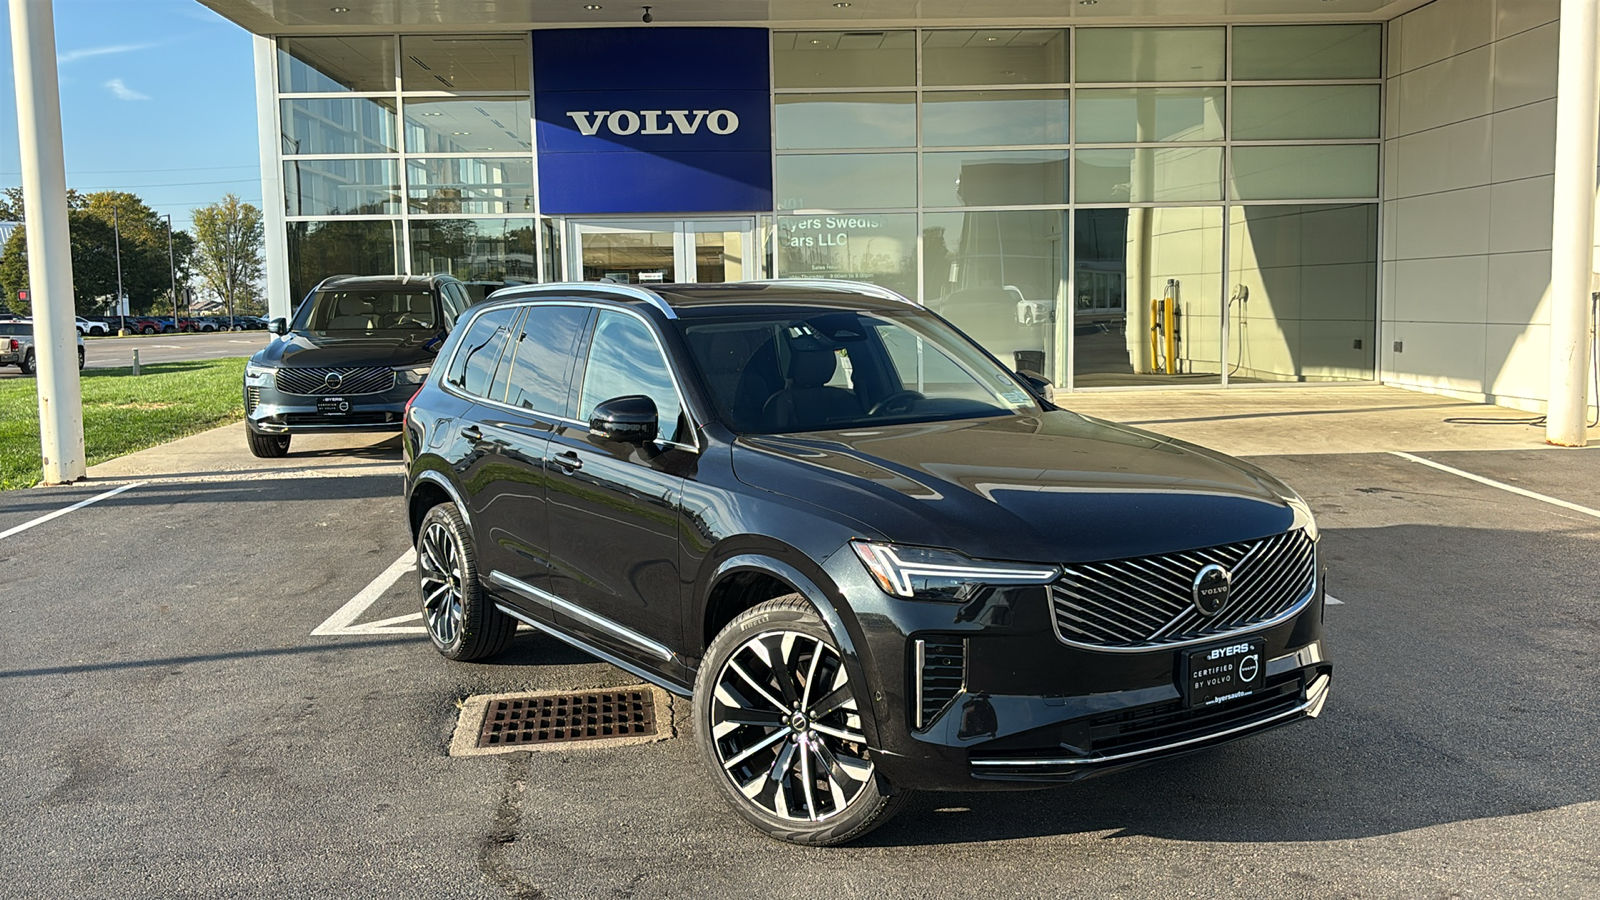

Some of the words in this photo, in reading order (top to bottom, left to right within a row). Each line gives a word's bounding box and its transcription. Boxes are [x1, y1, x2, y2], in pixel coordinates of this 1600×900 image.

[566, 109, 739, 136] VOLVO
[818, 232, 848, 247] LLC
[1201, 586, 1228, 596] VOLVO
[1211, 643, 1249, 659] BYERS
[1193, 664, 1233, 678] CERTIFIED
[1194, 681, 1205, 690] BY
[1206, 674, 1231, 687] VOLVO
